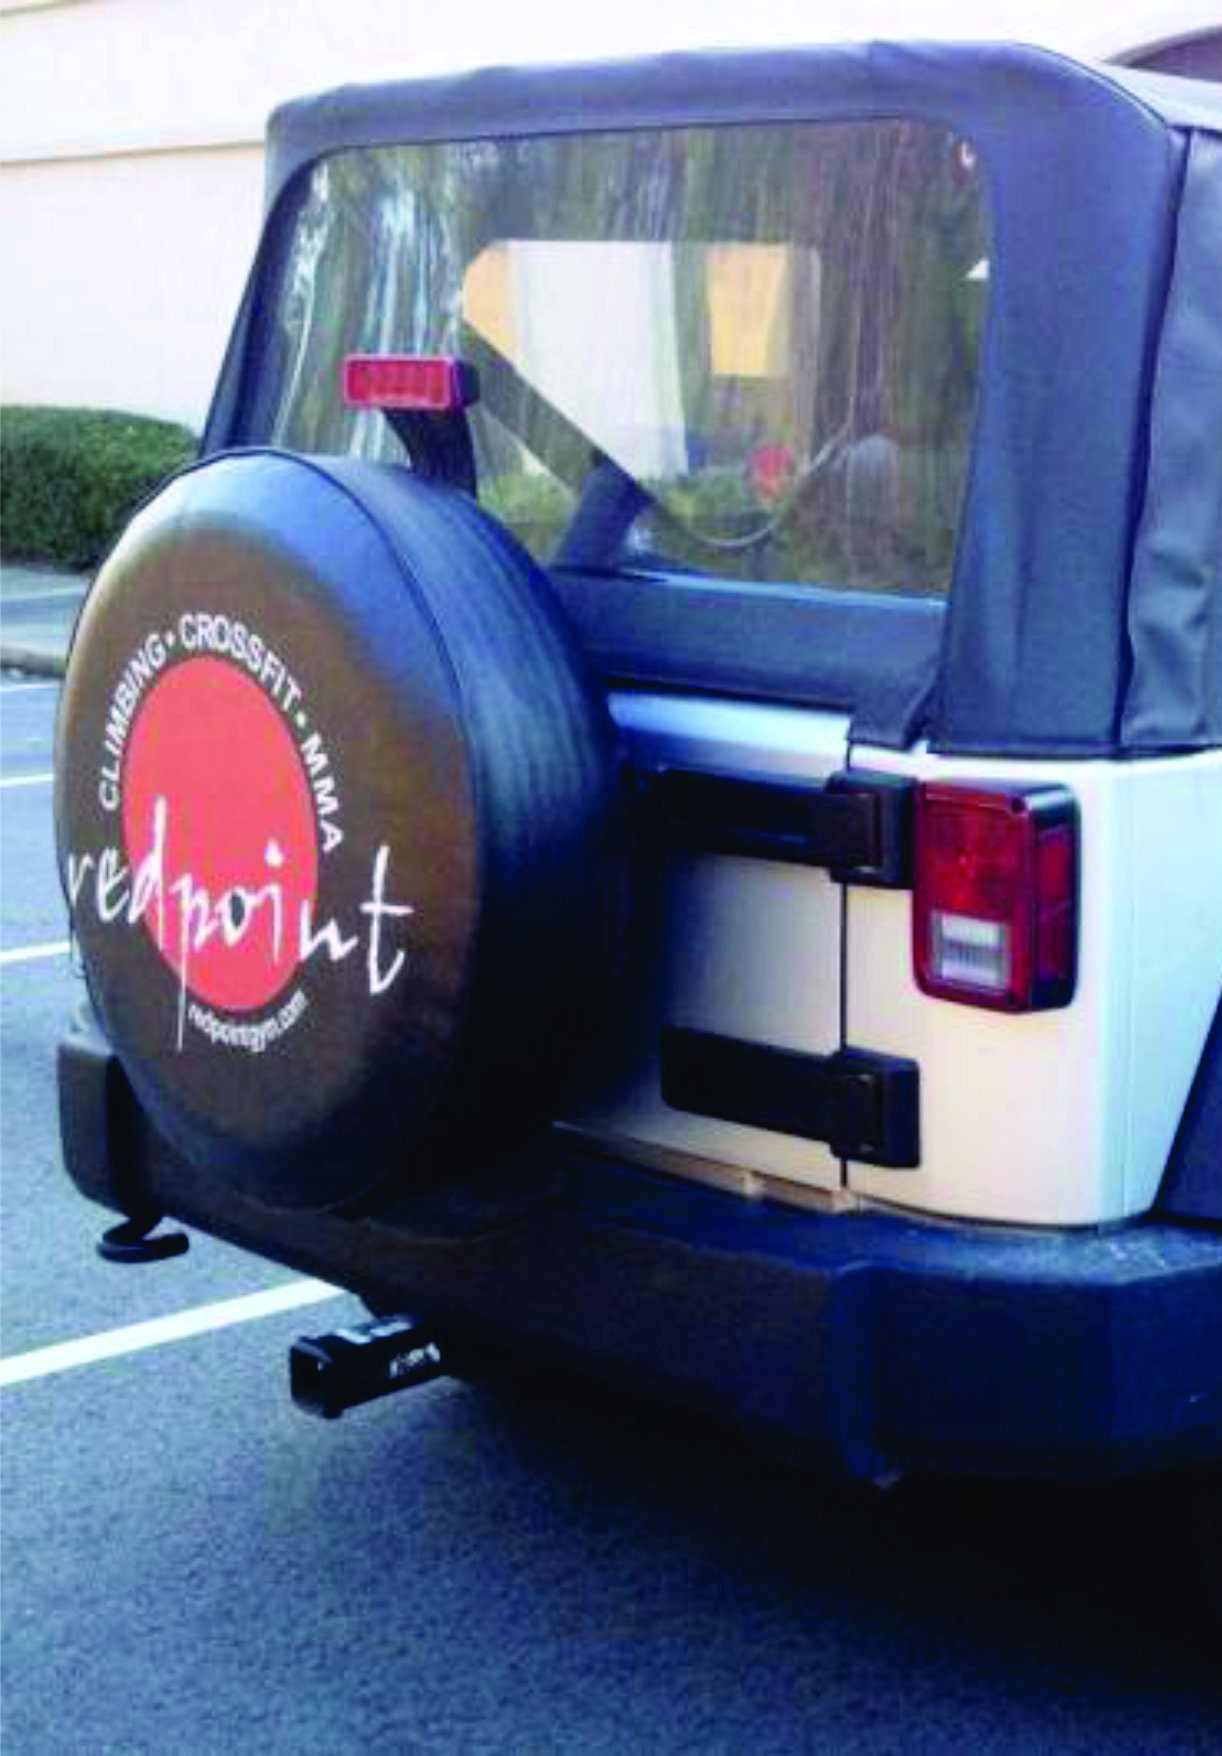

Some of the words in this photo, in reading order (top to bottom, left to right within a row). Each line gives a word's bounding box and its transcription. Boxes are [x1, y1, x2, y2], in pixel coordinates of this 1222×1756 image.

[99, 633, 167, 811] CLIMBING
[178, 613, 302, 711] CROSSFIT
[301, 732, 344, 854] MMA
[67, 794, 415, 1052] redpoint
